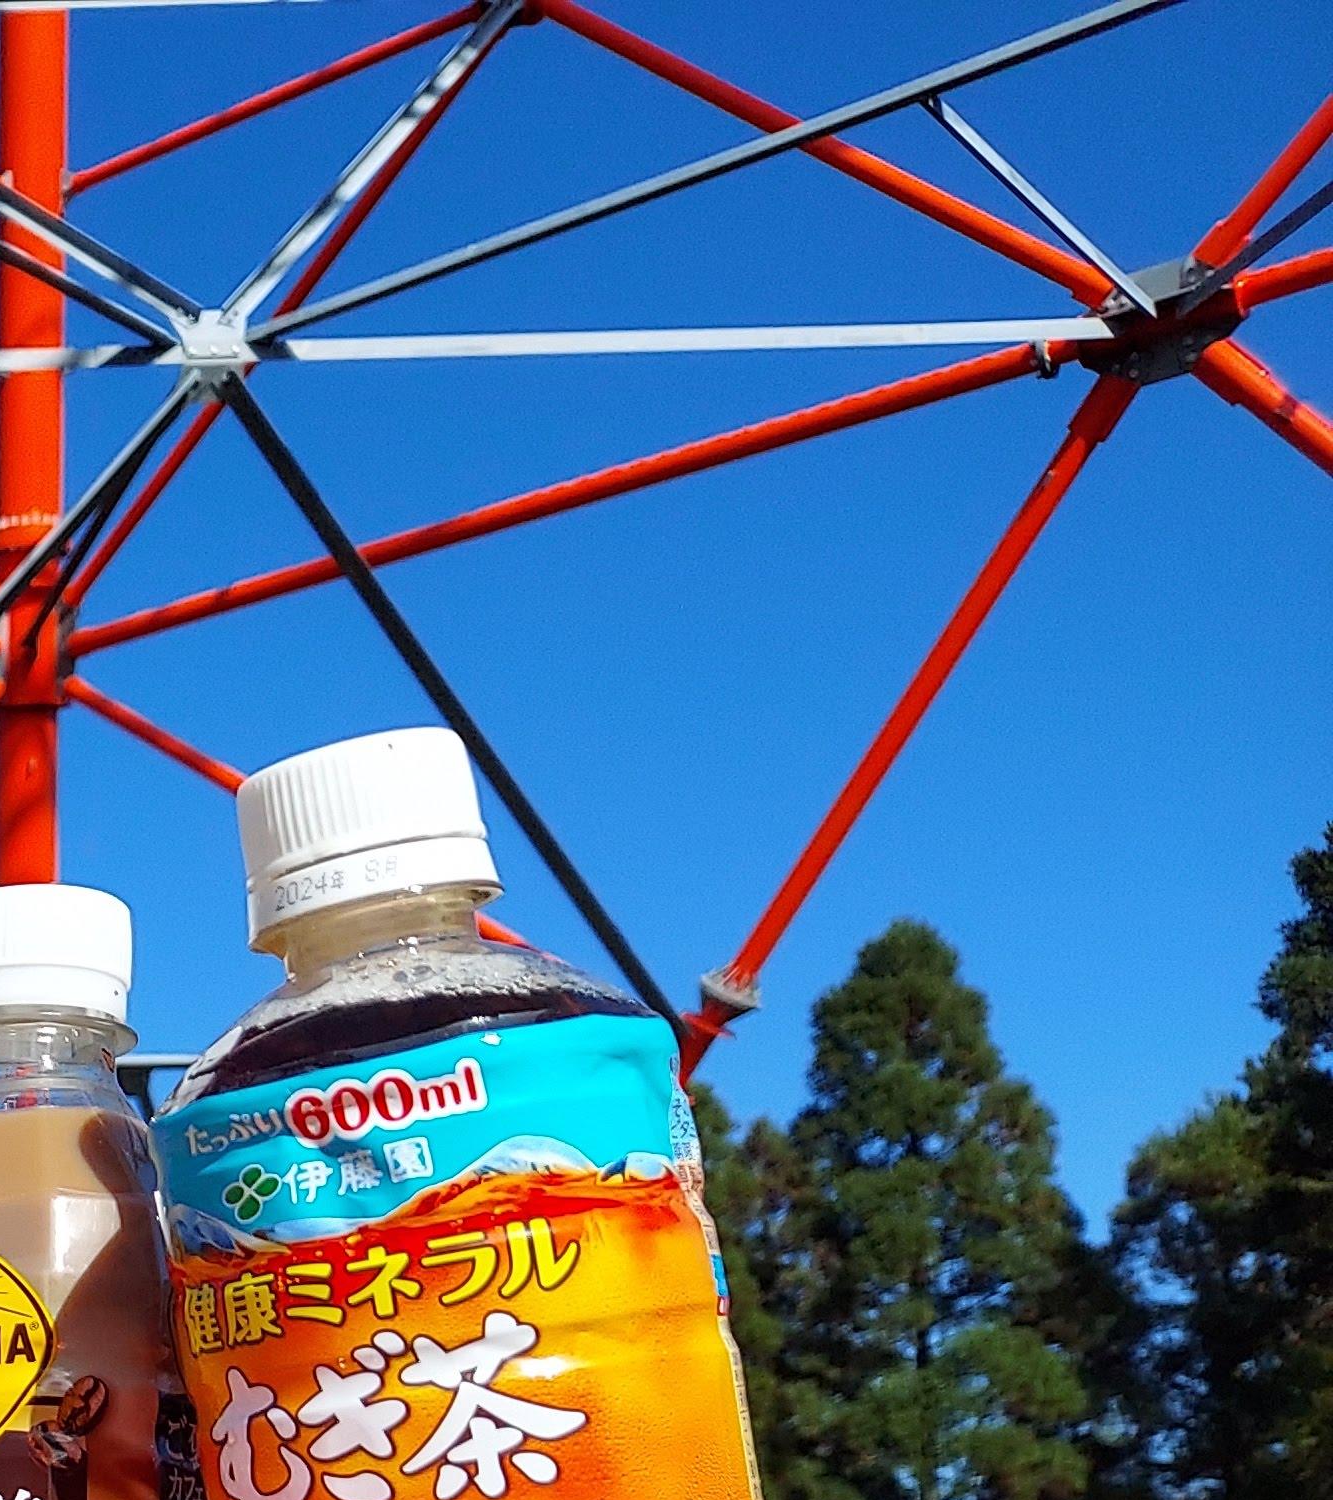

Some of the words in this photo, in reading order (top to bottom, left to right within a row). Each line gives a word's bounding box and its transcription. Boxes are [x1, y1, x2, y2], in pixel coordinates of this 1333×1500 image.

[283, 1136, 433, 1205] 伊藤園
[183, 1216, 582, 1358] 健康ミネラル
